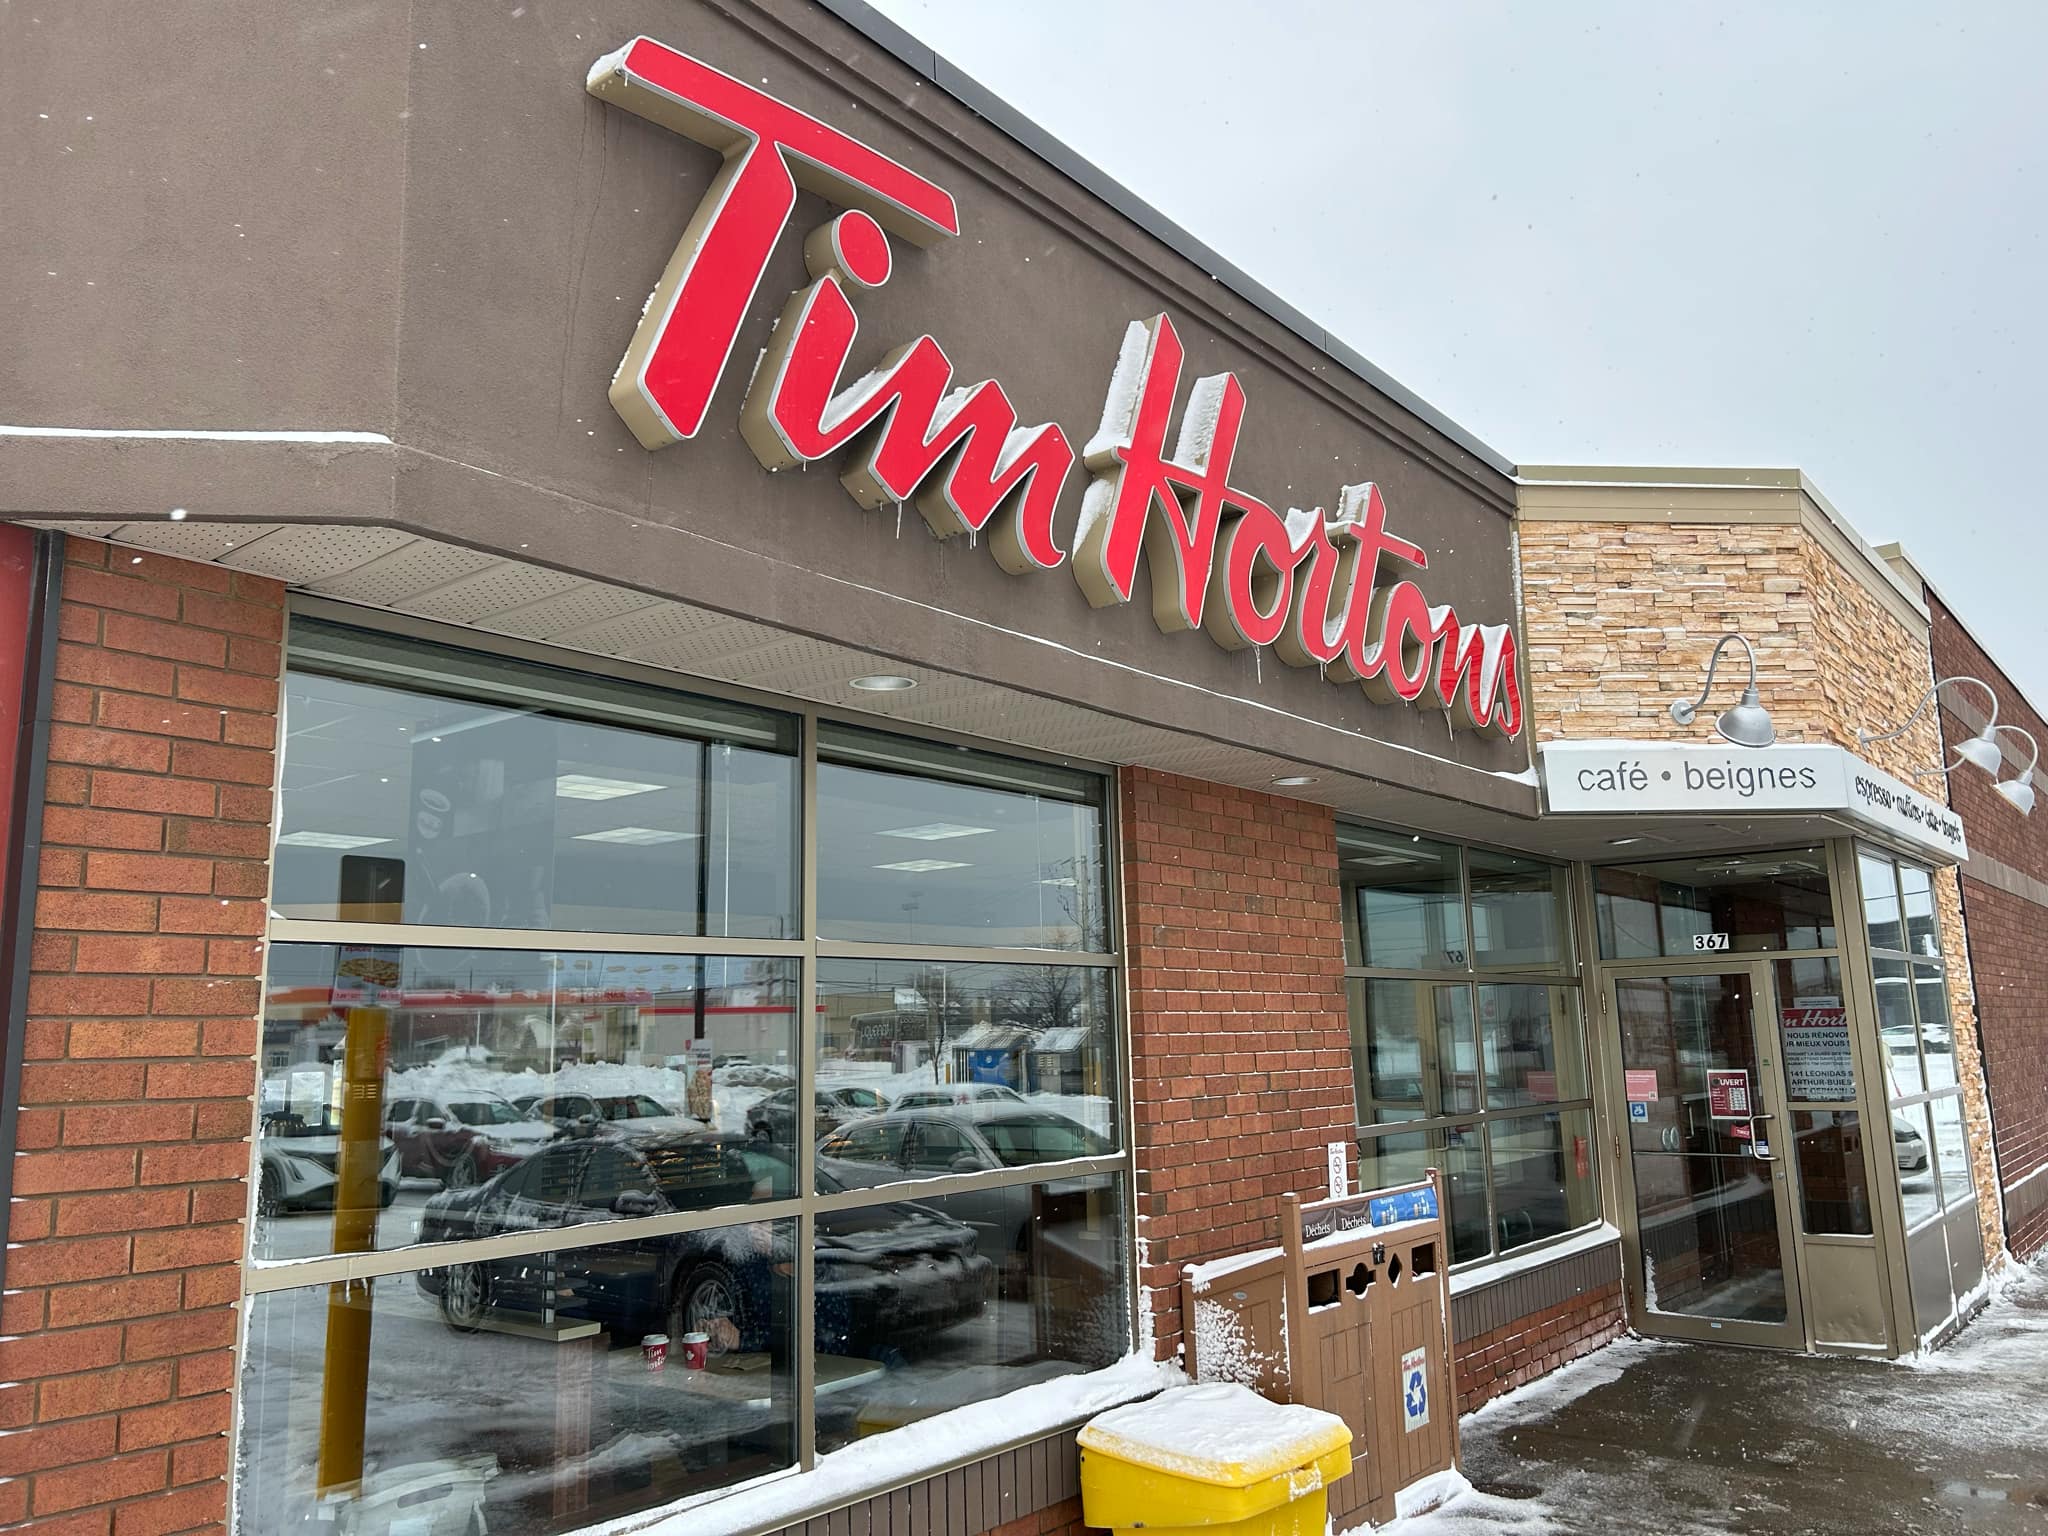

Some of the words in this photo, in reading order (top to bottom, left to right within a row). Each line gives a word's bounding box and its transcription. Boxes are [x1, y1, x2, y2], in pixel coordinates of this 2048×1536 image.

[612, 36, 1076, 571] Tim
[1085, 312, 1524, 738] Hortons
[1577, 760, 1649, 791] café
[1683, 759, 1817, 797] beignes
[1855, 775, 1891, 808] espresso
[1695, 934, 1727, 949] 367
[1802, 1009, 1848, 1027] Hort
[1786, 1032, 1810, 1040] NOUS
[1712, 1077, 1745, 1087] UVERT
[1304, 1222, 1331, 1239] Déchets
[1341, 1215, 1367, 1231] Déchets
